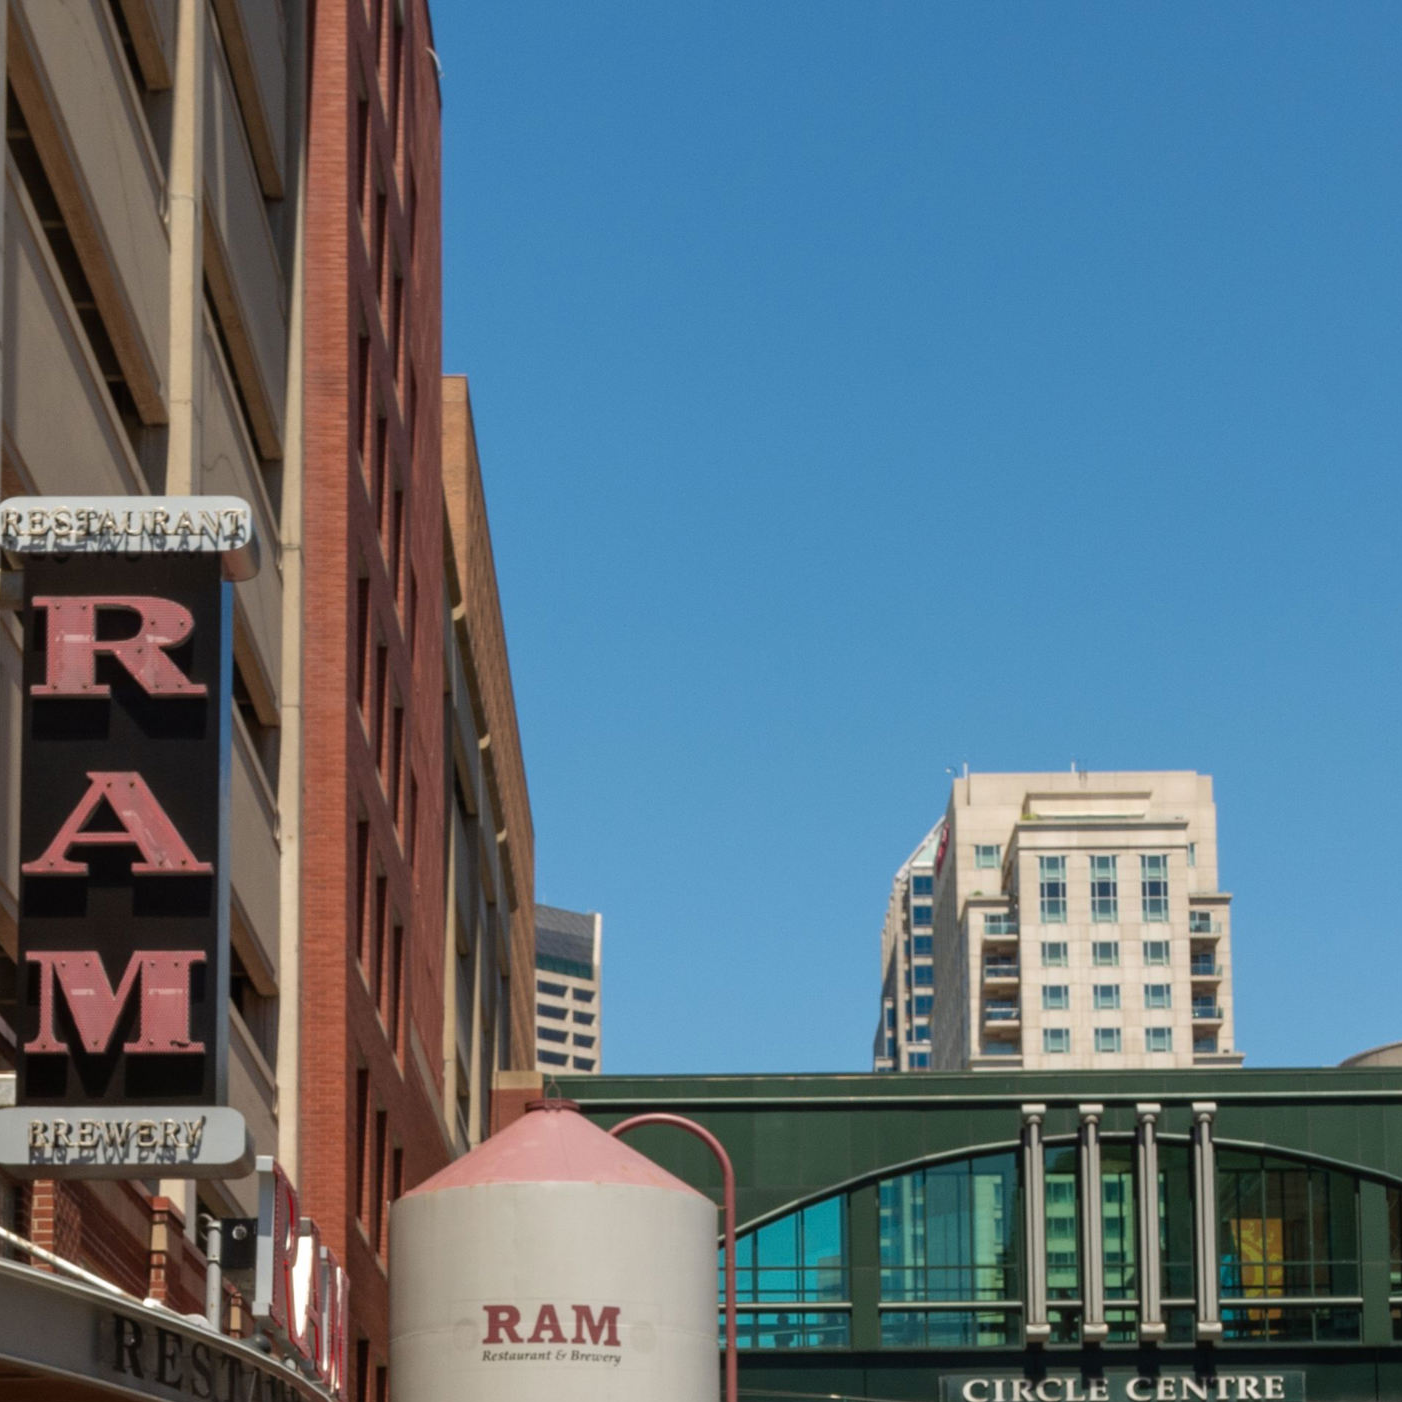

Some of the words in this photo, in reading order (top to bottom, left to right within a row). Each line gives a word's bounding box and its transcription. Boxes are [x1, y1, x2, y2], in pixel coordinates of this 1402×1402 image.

[1, 506, 248, 537] RESTAURANT
[21, 595, 214, 1054] RAM
[27, 1115, 207, 1149] BREWERY
[482, 1303, 622, 1347] RAM
[482, 1350, 551, 1362] Restaurant
[555, 1350, 567, 1361] &
[571, 1350, 622, 1367] Brewery
[1125, 1375, 1286, 1402] CENTRE
